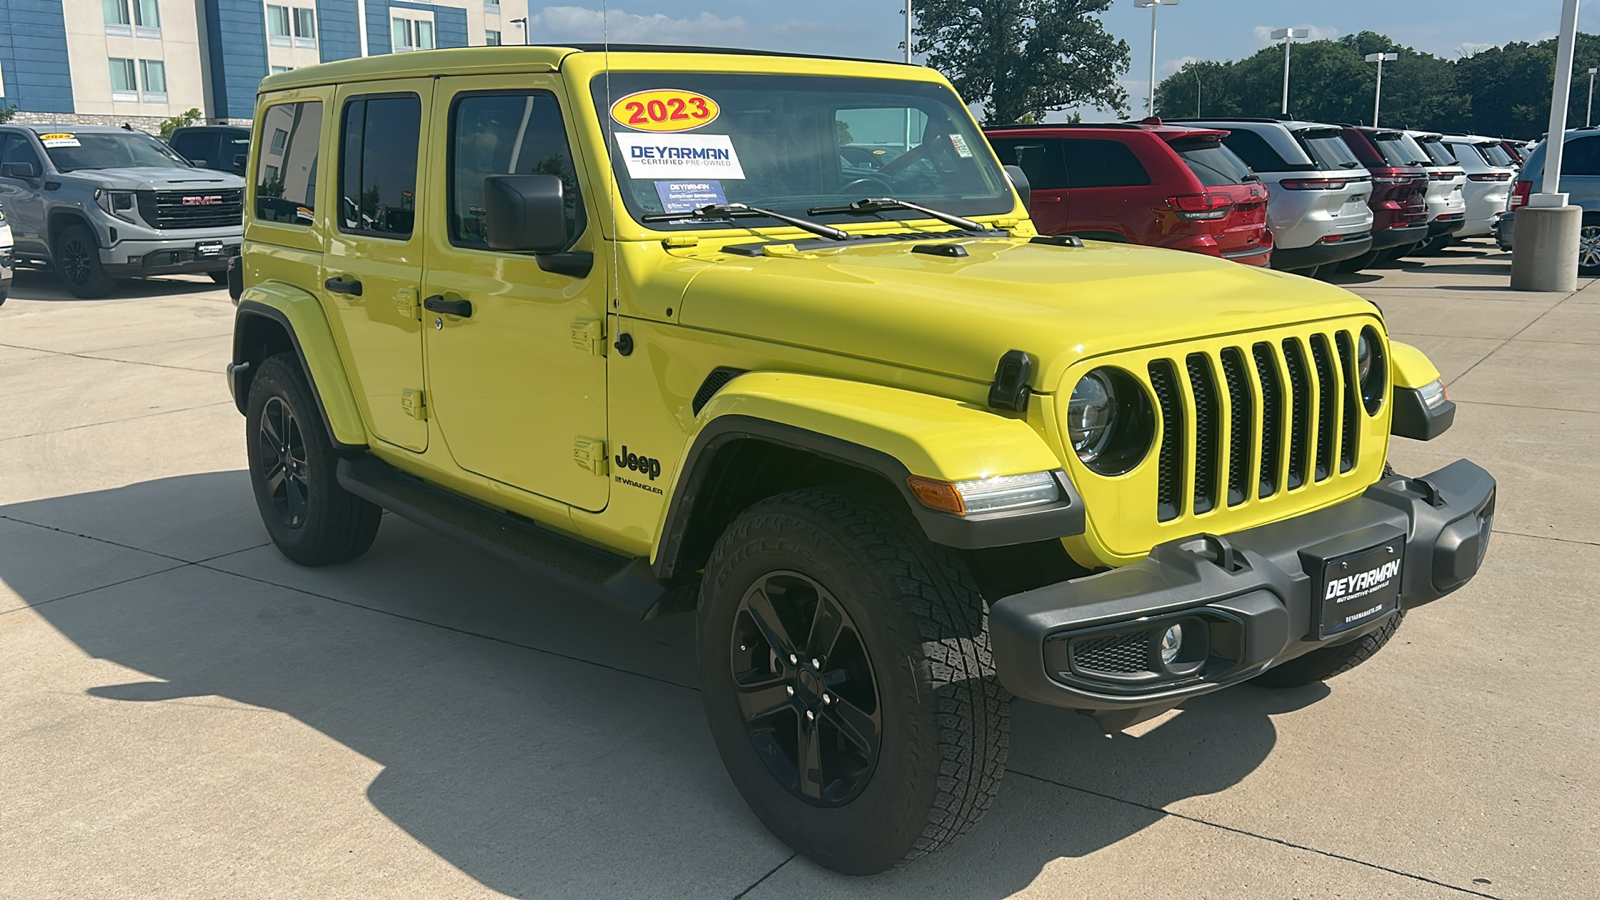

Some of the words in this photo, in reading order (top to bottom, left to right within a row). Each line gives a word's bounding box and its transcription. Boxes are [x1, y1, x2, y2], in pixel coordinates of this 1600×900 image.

[625, 97, 710, 124] 2023
[630, 146, 729, 160] DEYARMAN
[641, 158, 684, 166] CERTIFIED
[182, 195, 223, 206] GMC
[615, 445, 661, 481] Jeep
[621, 477, 664, 496] WRANGLER
[1325, 558, 1401, 600] DEYARMAN
